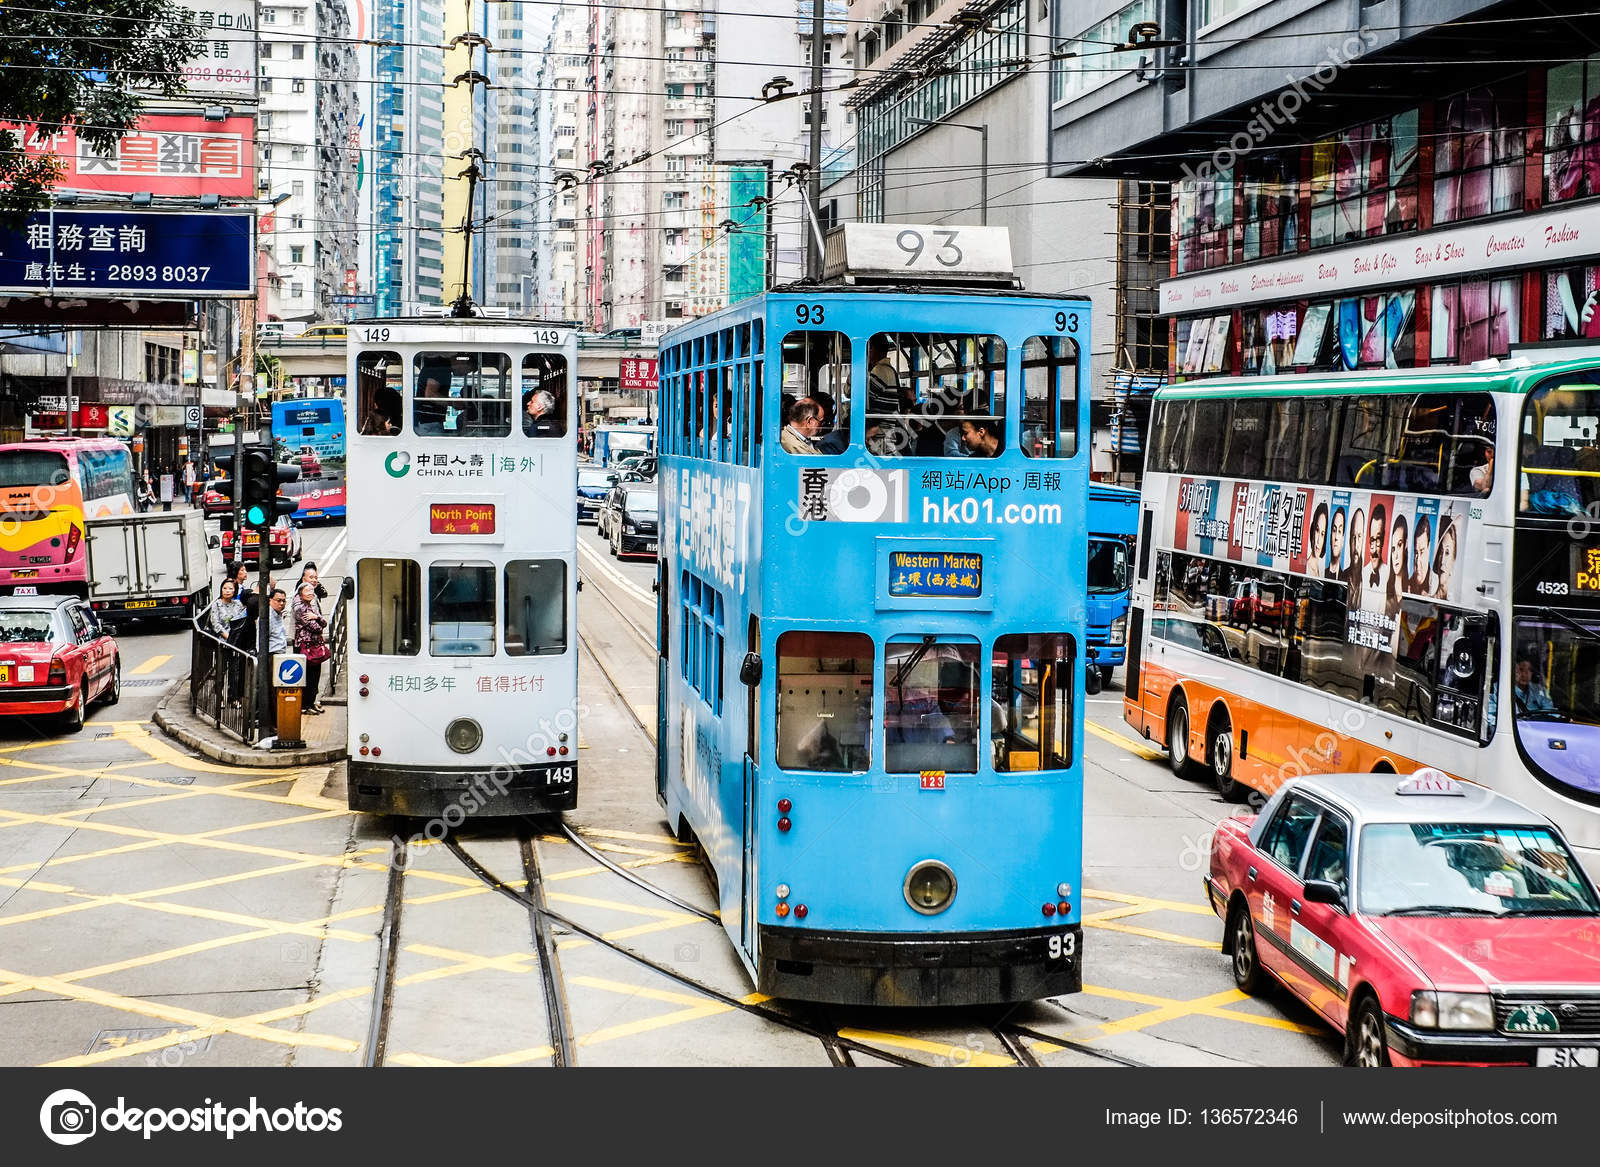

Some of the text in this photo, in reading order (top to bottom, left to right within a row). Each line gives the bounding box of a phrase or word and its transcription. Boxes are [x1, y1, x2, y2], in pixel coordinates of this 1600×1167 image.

[217, 68, 250, 83] 8534
[27, 224, 146, 252] 租務查詢
[896, 229, 963, 267] 93
[1318, 263, 1339, 280] Beauty
[1354, 256, 1371, 274] Books
[1415, 247, 1432, 268] Bags
[1435, 246, 1441, 261] &
[1443, 243, 1465, 261] Shoes
[1486, 235, 1525, 257] Cosmetics
[1544, 223, 1580, 248] Fashion
[108, 265, 157, 281] 2893
[162, 266, 211, 282] 8037
[795, 304, 825, 325] 93
[1055, 311, 1079, 333] 93
[364, 327, 390, 343] 149
[535, 330, 559, 345] 149
[625, 380, 642, 388] KONG
[416, 453, 536, 473] 中國人壽 海外
[416, 469, 484, 477] CHINA LIFE
[802, 468, 829, 522] 香港
[431, 509, 493, 520] North Point
[922, 497, 1062, 524] hk01.com
[895, 554, 981, 569] Western Market
[15, 587, 35, 595] TAXI
[1536, 581, 1568, 596] 4523
[388, 675, 545, 693] 相知多年 值得托付
[545, 767, 573, 784] 149
[1415, 781, 1451, 791] TAXI
[1049, 933, 1075, 959] 93
